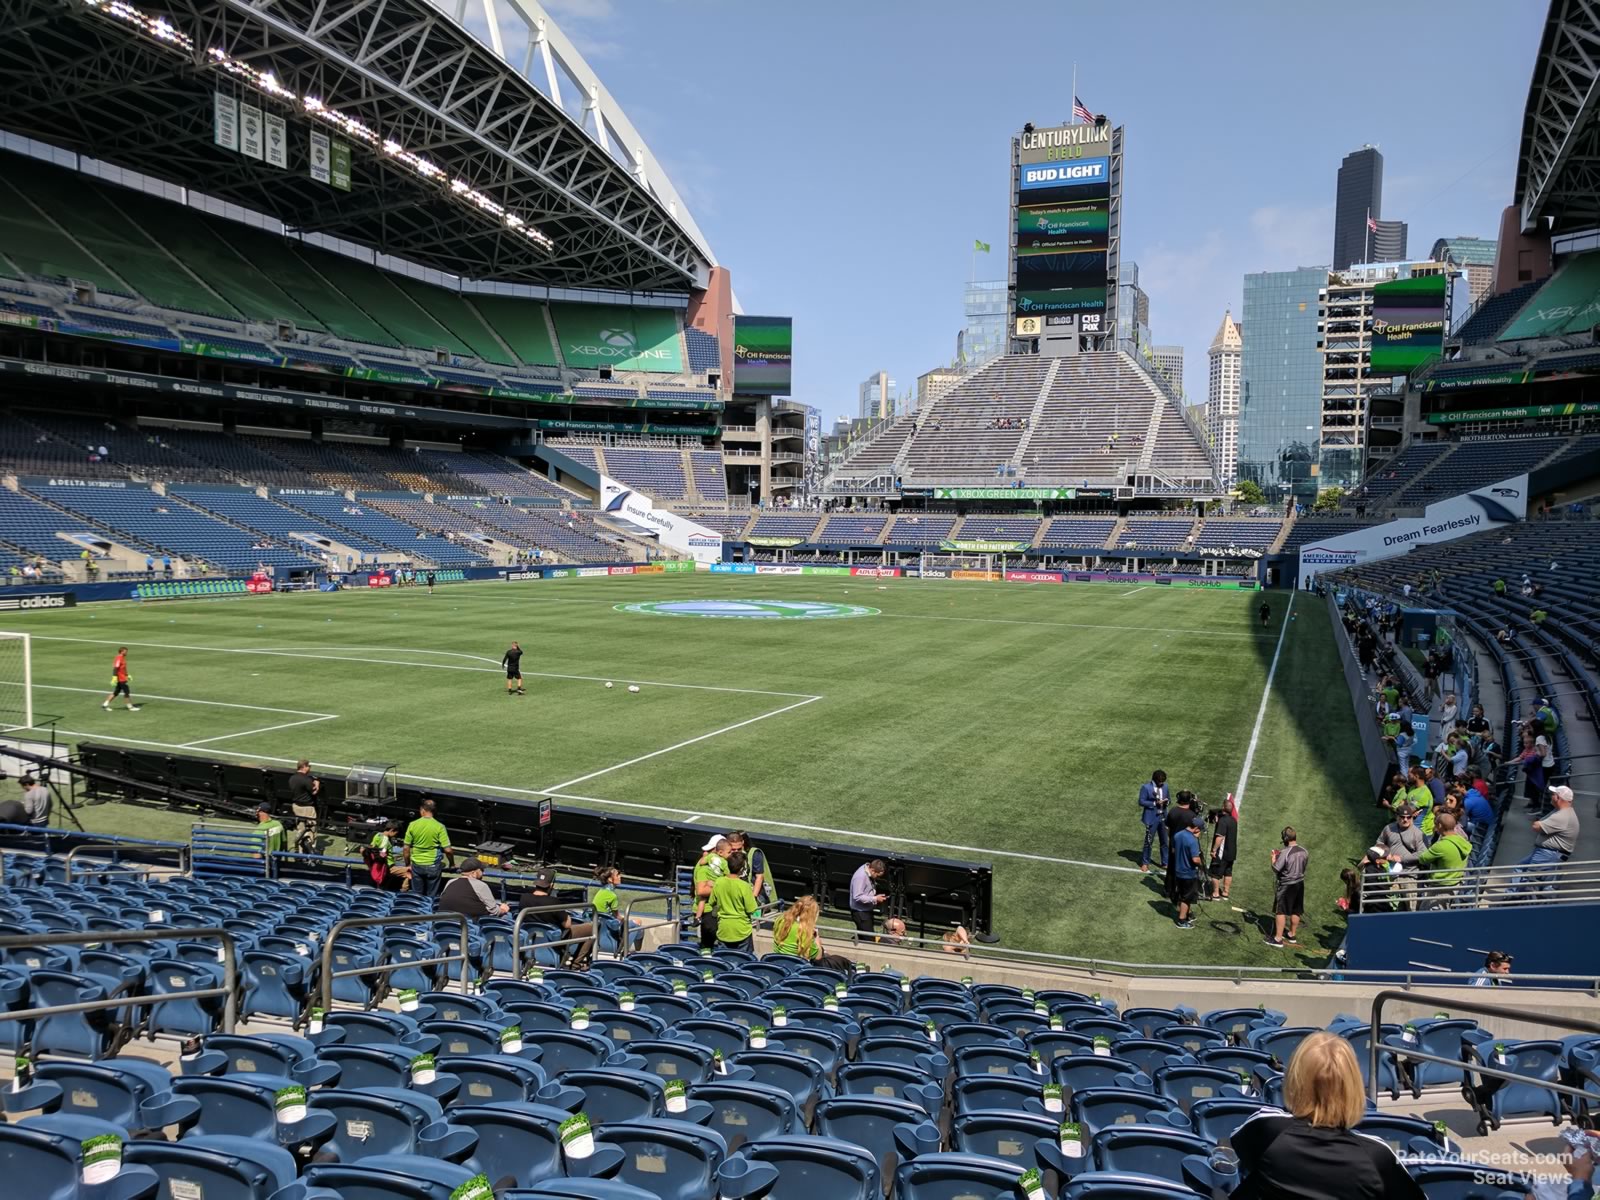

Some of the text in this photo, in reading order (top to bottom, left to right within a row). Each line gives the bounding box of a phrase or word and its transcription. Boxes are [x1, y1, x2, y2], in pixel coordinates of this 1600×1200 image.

[1047, 146, 1082, 160] FIELD
[1027, 164, 1102, 182] BUD LIGHT
[1066, 206, 1090, 214] presented
[1048, 228, 1067, 236] Health
[1044, 302, 1080, 310] Franciscan
[1080, 300, 1104, 308] Health
[1082, 314, 1100, 324] Q13
[1082, 323, 1099, 331] FOX
[1386, 321, 1443, 333] CHI Franciscan
[1387, 332, 1413, 341] Health
[570, 345, 672, 359] XBOX ONE
[1472, 377, 1512, 386] #NWhealthy
[360, 405, 395, 415] RING OF HONOR
[1581, 403, 1598, 411] Own
[1448, 408, 1527, 421] CHI Franciscan Health
[566, 422, 595, 430] Franciscan
[1460, 433, 1507, 442] BROTHERTON
[960, 489, 1048, 499] XBOX GREEN ZONE
[626, 504, 674, 531] Insure Carefully
[1383, 514, 1481, 547] Dream Fearlessly
[953, 571, 987, 579] Continental
[1107, 576, 1139, 584] StubHub
[1188, 578, 1221, 588] StubHub
[20, 595, 65, 608] adidas
